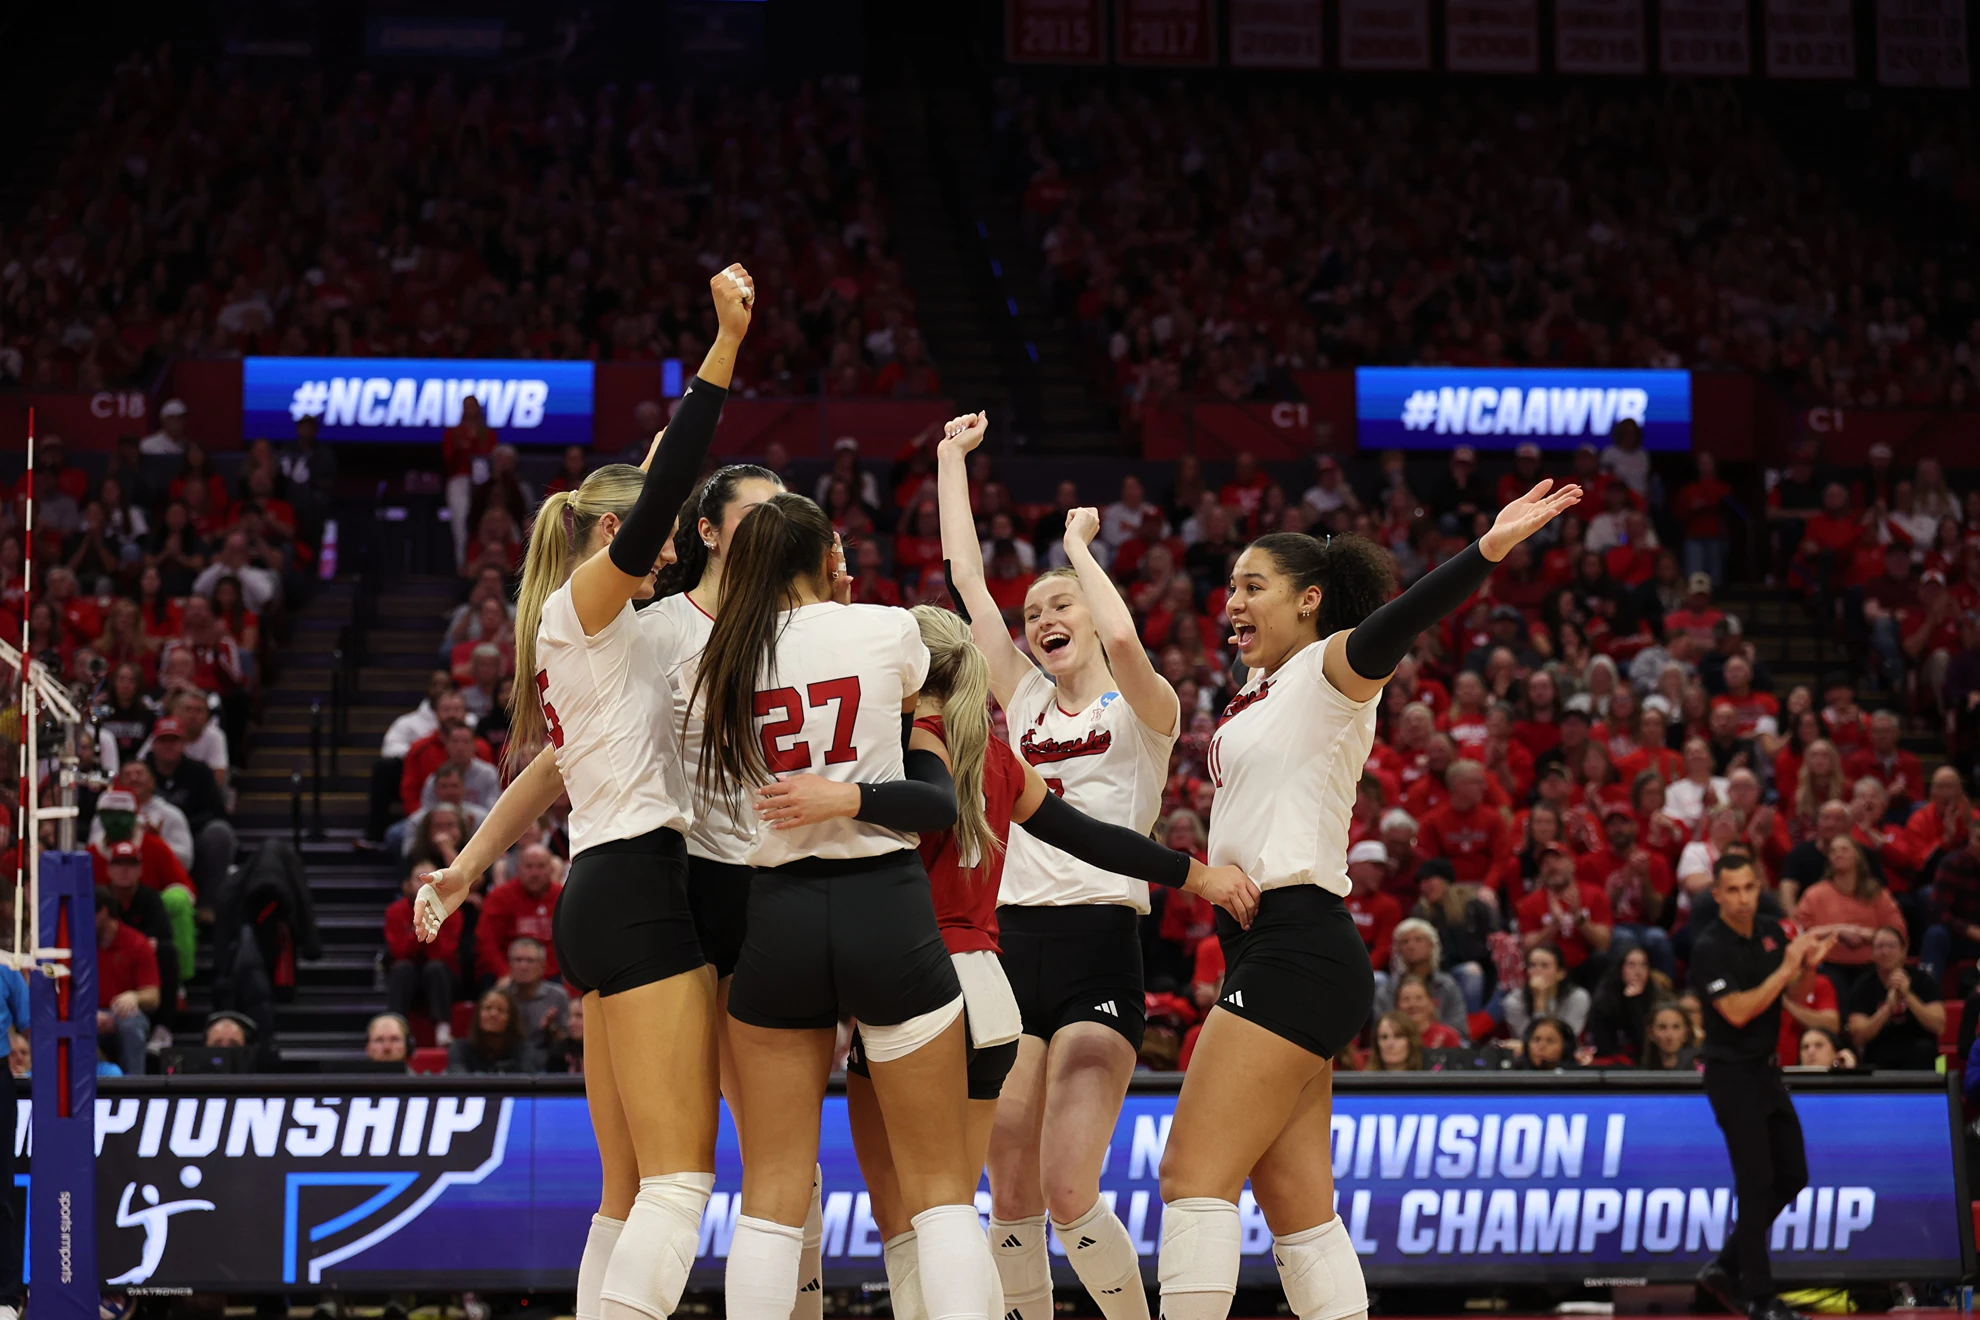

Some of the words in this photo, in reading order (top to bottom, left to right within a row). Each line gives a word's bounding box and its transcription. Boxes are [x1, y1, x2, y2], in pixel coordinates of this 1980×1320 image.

[1020, 16, 1093, 54] 2015
[1130, 19, 1199, 56] 2017
[91, 392, 146, 419] C18
[1272, 402, 1308, 427] C1
[1808, 407, 1844, 432] C1
[754, 675, 862, 774] 27
[15, 1099, 487, 1157] PIONSHIP
[1329, 1114, 1589, 1180] DIVISION
[1602, 1114, 1626, 1178] I
[1397, 1186, 1877, 1255] CHAMPIONHIP
